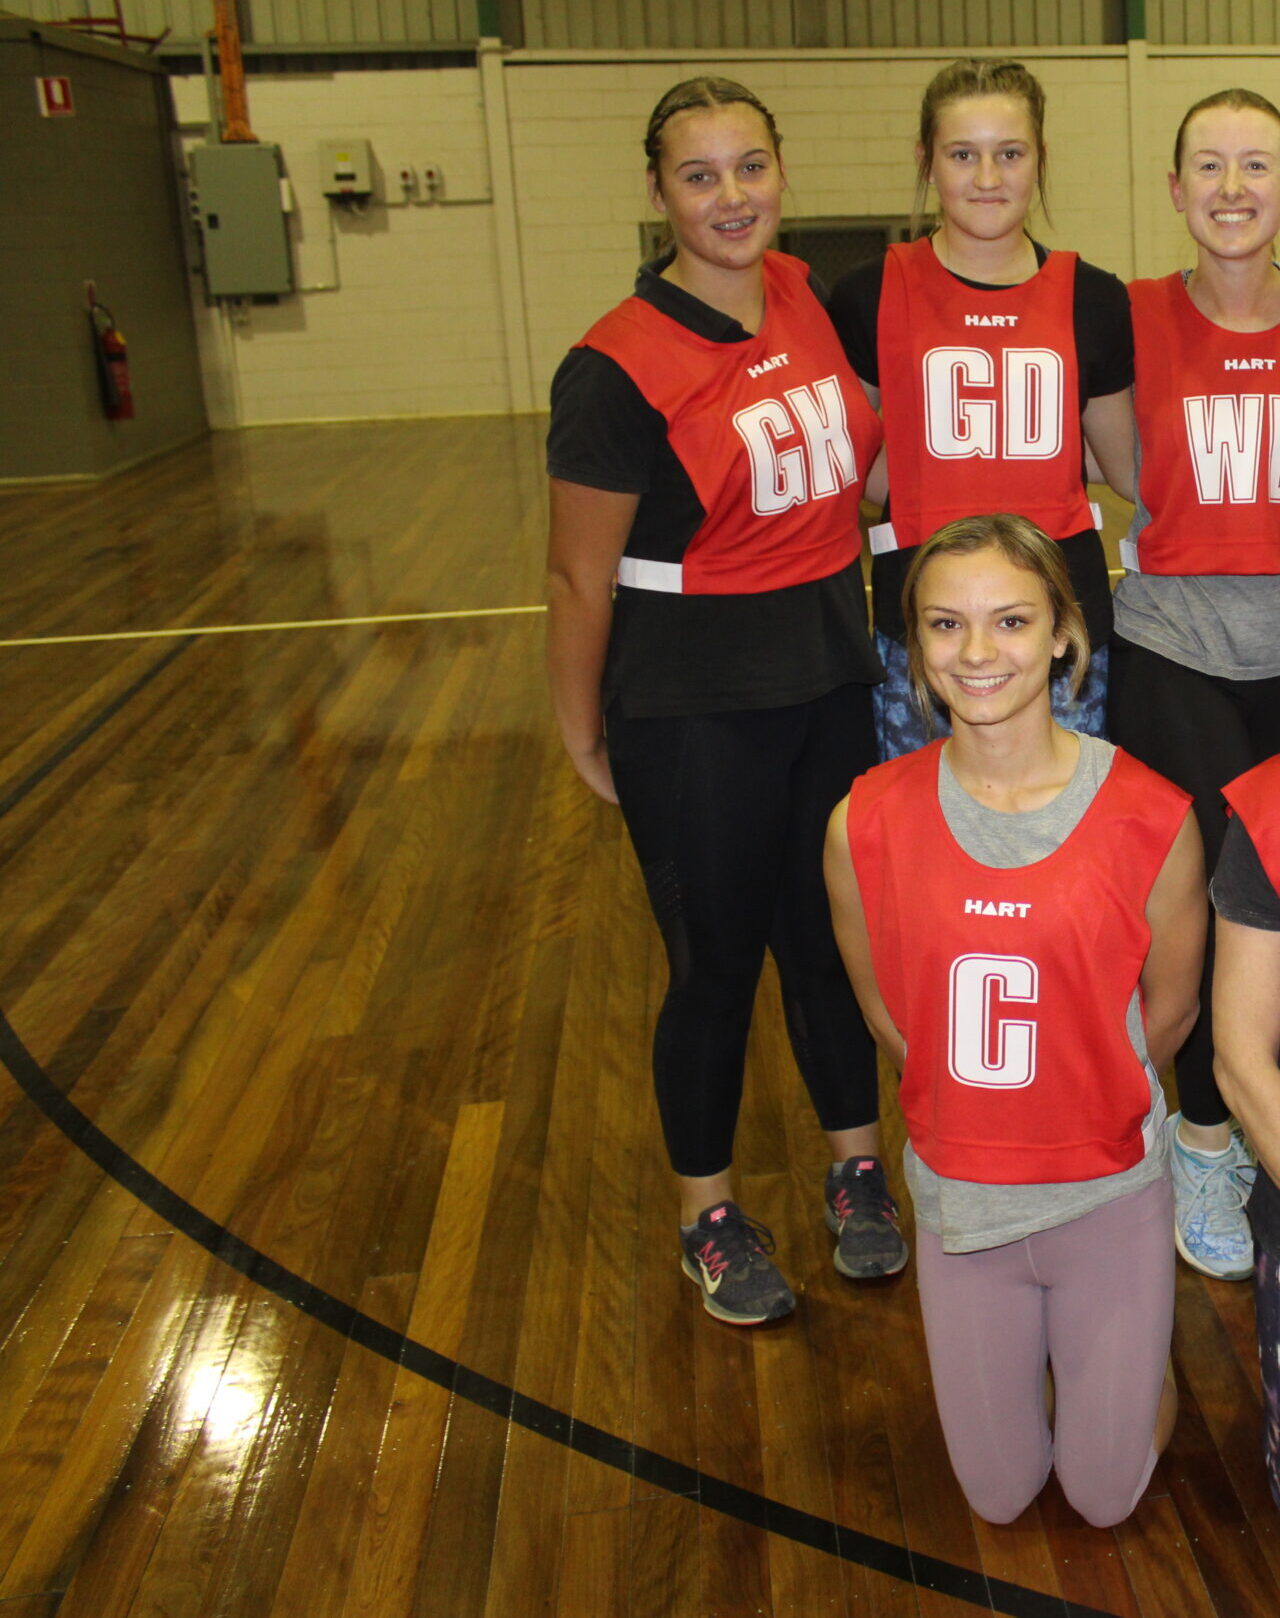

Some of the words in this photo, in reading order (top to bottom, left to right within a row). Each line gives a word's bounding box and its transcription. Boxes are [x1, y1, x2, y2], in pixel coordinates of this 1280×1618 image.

[964, 314, 1019, 327] HART
[747, 353, 789, 379] HART
[1224, 358, 1277, 371] HART
[923, 347, 1063, 460] GD
[732, 375, 858, 516] GK
[964, 899, 1033, 919] HART
[948, 953, 1038, 1089] C
